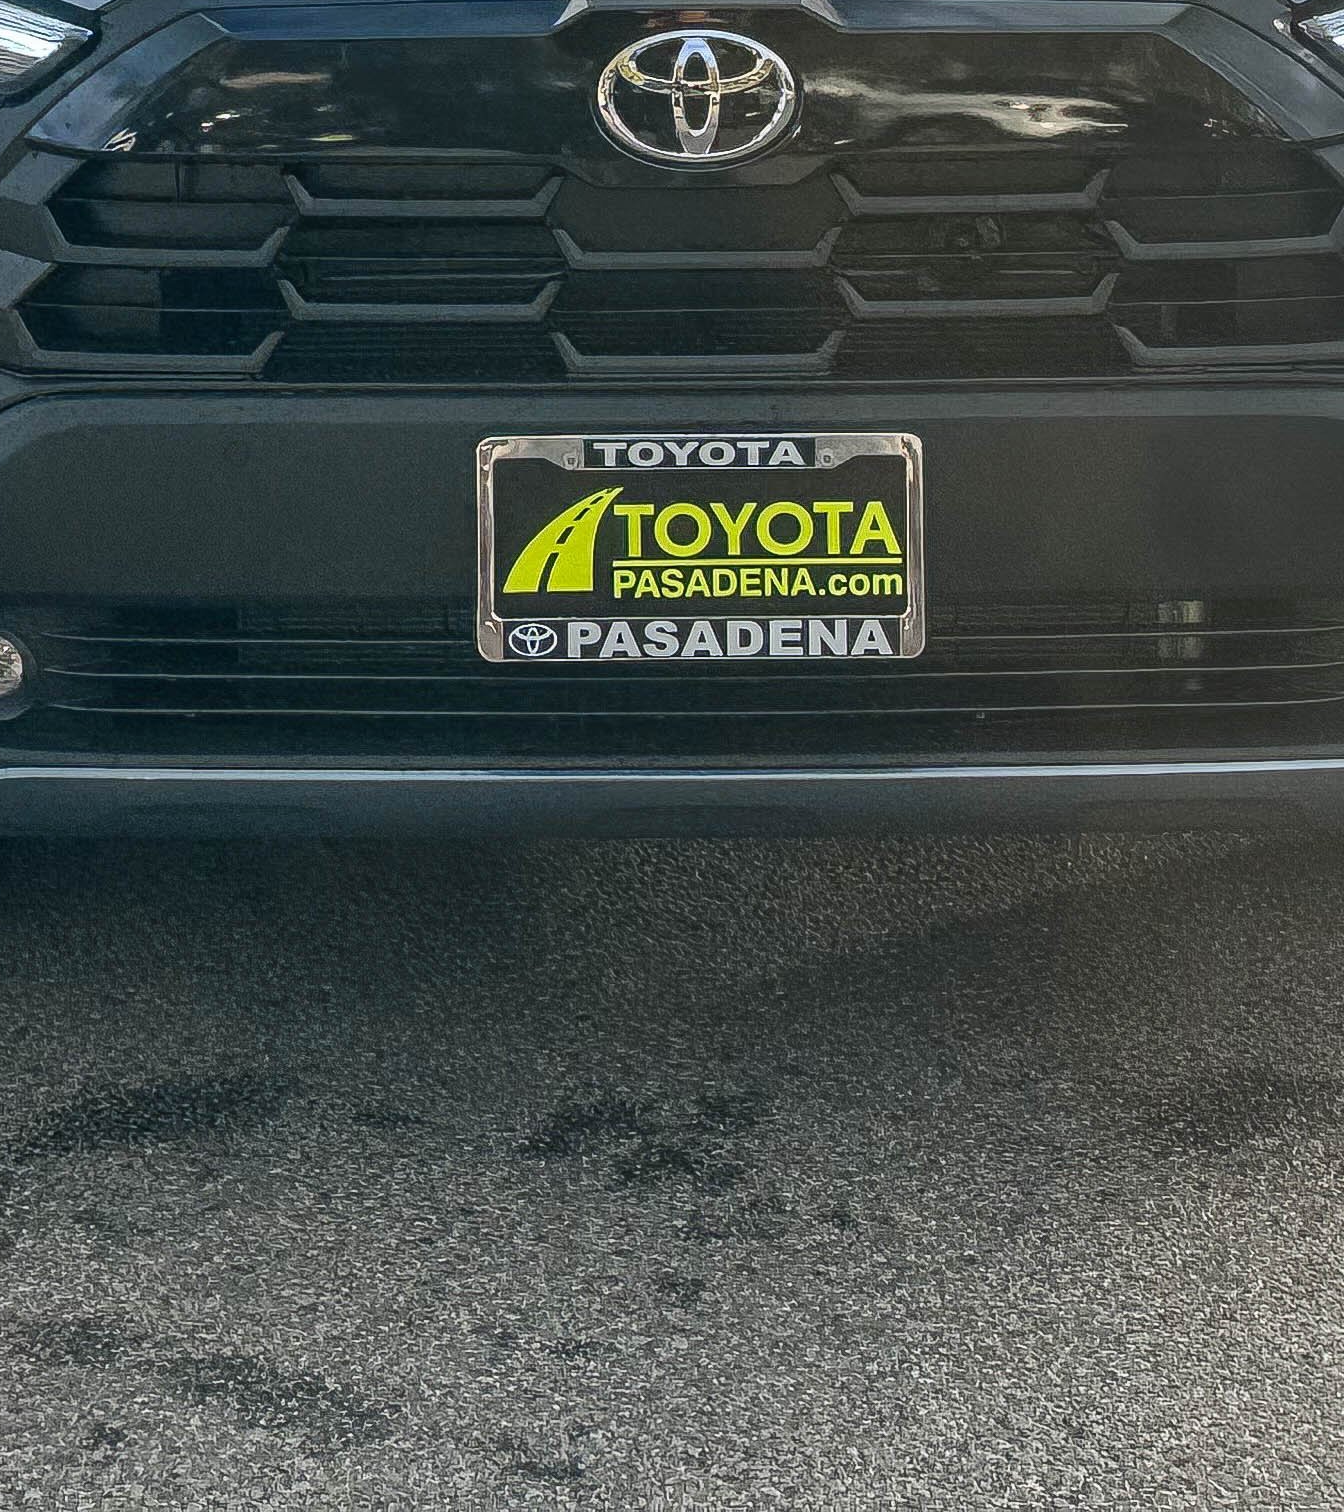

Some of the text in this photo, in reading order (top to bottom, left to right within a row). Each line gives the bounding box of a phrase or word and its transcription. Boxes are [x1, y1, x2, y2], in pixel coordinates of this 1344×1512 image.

[593, 441, 805, 467] TOYOTA
[613, 501, 902, 557] TOYOTA
[612, 567, 903, 599] PASADENA.com
[567, 620, 893, 658] PASADENA
